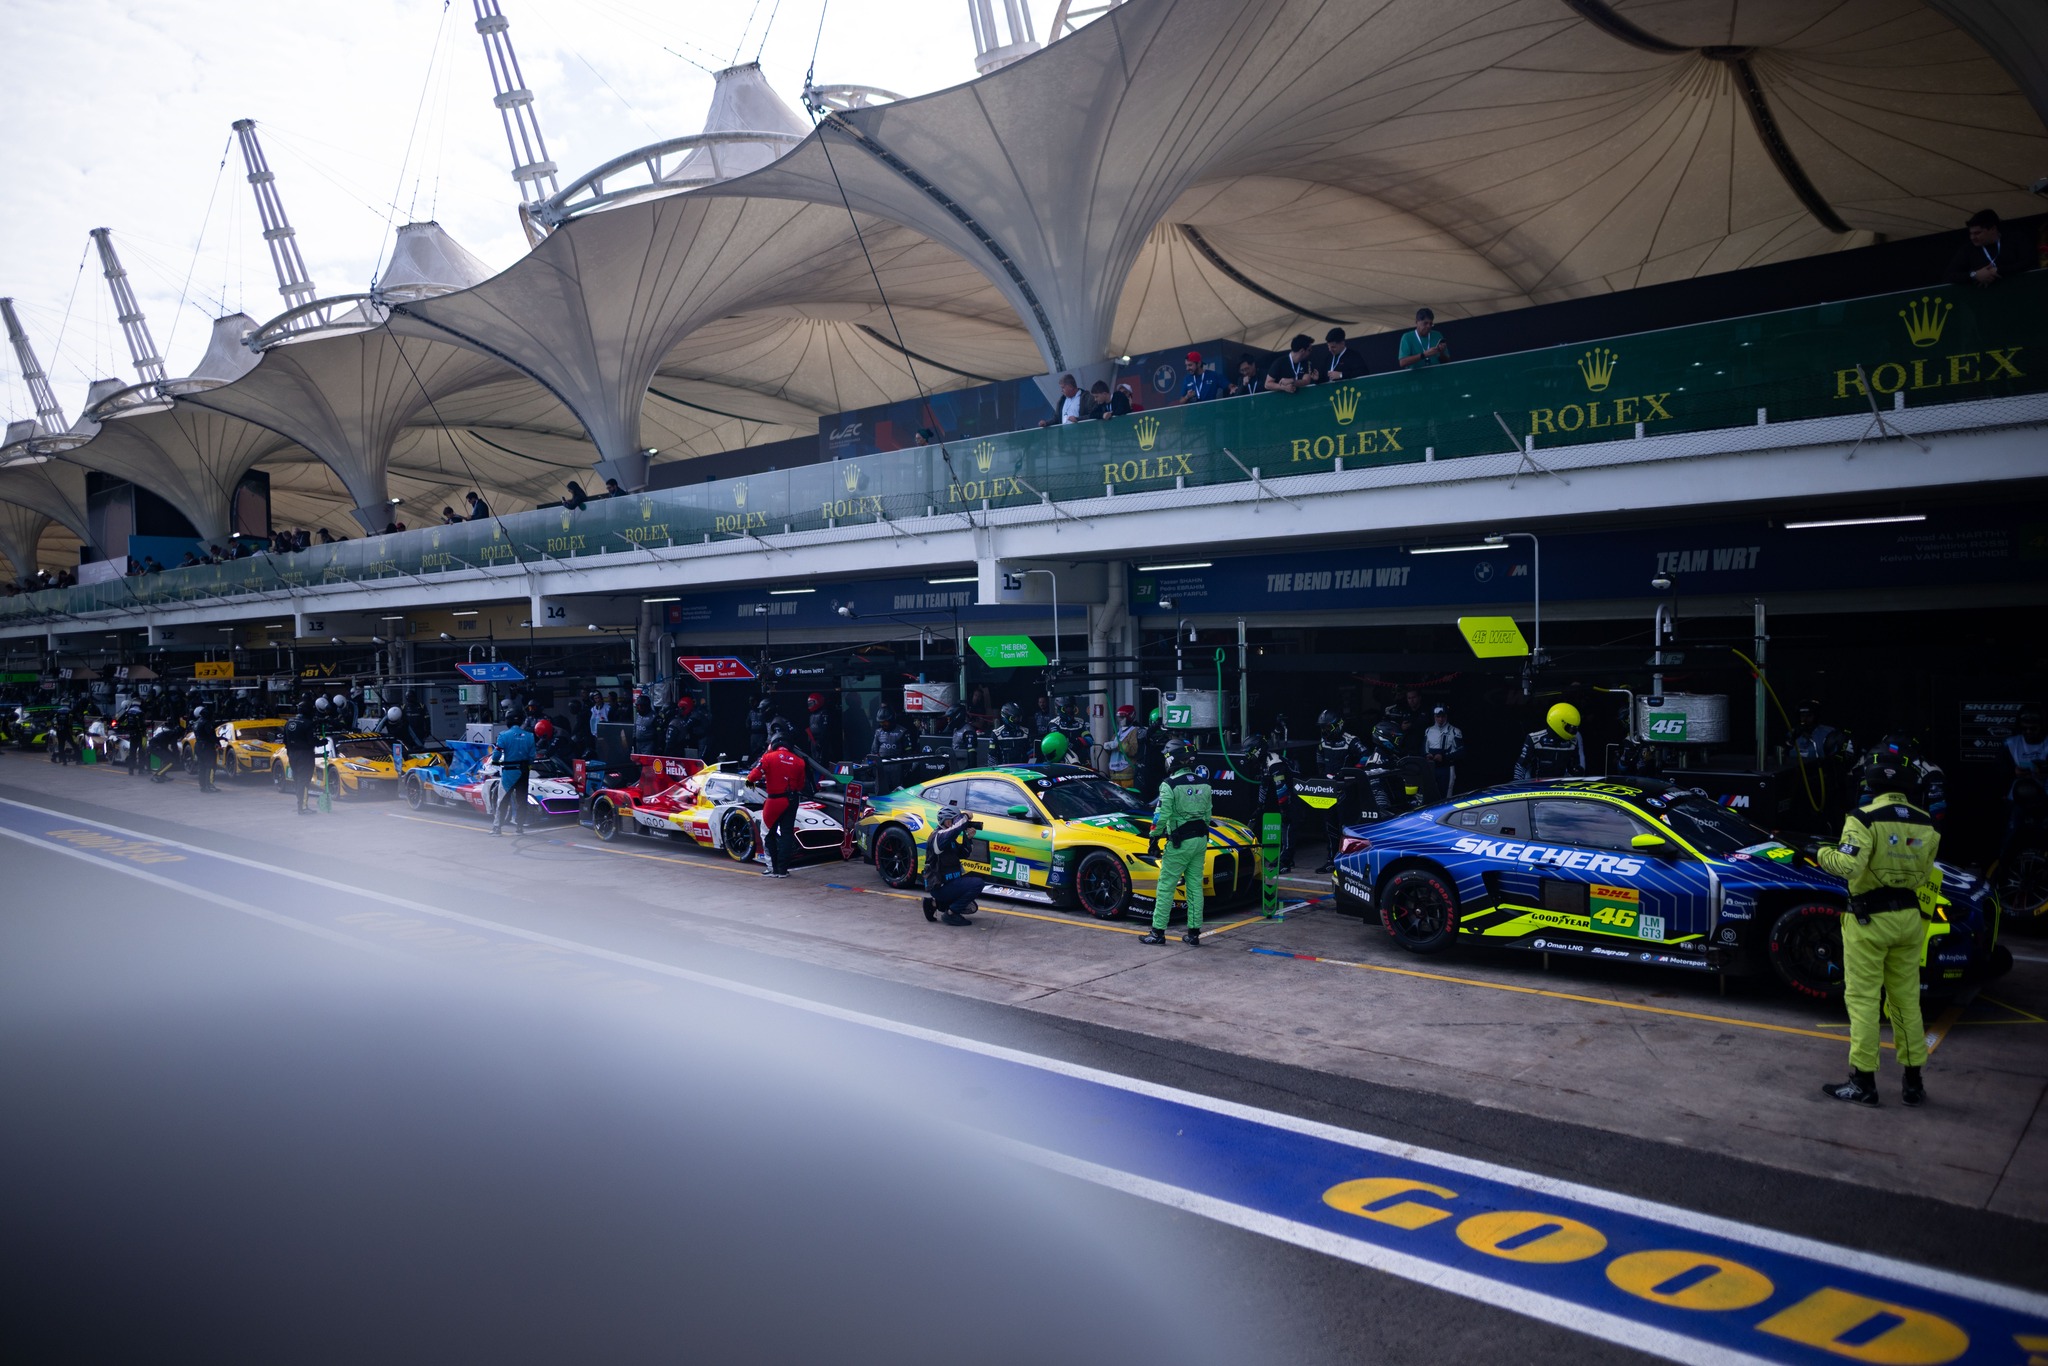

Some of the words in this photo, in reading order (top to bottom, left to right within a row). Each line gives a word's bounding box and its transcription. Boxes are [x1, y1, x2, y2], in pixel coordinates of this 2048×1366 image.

[1833, 346, 2028, 400] ROLEX
[1529, 392, 1674, 436] ROLEX
[1290, 427, 1405, 463] ROLEX
[1103, 453, 1194, 485] ROLEX
[949, 476, 1024, 503] ROLEX
[822, 494, 885, 520] ROLEX
[715, 511, 768, 533] ROLEX
[625, 524, 669, 544] ROLEX
[547, 534, 586, 552] ROLEX
[480, 544, 515, 560] ROLEX
[422, 552, 452, 566] ROLEX
[1656, 549, 1707, 574] TEAM
[1712, 546, 1761, 571] WRT
[324, 566, 347, 579] ROLEX
[370, 558, 396, 574] ROLEX
[1004, 574, 1022, 590] 15
[1267, 574, 1291, 592] THE
[1294, 571, 1331, 592] BEND
[1334, 568, 1373, 590] TEAM
[1376, 566, 1410, 587] WRT
[1136, 585, 1152, 596] 31
[894, 594, 915, 610] BMW
[925, 592, 948, 608] TEAM
[950, 591, 970, 607] WRT
[548, 606, 566, 618] 14
[782, 601, 798, 615] WRT
[309, 622, 324, 632] 13
[162, 632, 174, 640] 12
[1472, 630, 1487, 644] 46
[1488, 630, 1516, 644] WRT
[1014, 650, 1029, 658] WRT
[59, 668, 73, 679] 38
[114, 666, 129, 678] 12
[300, 669, 320, 678] #81
[472, 668, 486, 676] 15
[694, 664, 714, 672] 20
[1168, 710, 1190, 724] 31
[1651, 719, 1685, 734] 46
[666, 766, 688, 776] HELIX
[1211, 788, 1232, 796] orsport
[1304, 784, 1334, 794] AnyDesk
[644, 818, 665, 828] iQOO
[694, 828, 712, 837] 20
[992, 844, 1012, 854] DHL
[1450, 838, 1646, 877] SKECHERS
[960, 860, 990, 872] GOODYEAR
[992, 856, 1014, 875] 31
[1018, 864, 1028, 873] LM
[1018, 872, 1028, 881] GT3
[1344, 876, 1372, 891] experience
[1344, 882, 1370, 902] oman
[1596, 888, 1632, 900] DHL
[1128, 906, 1154, 915] GOODYE
[1593, 906, 1637, 928] 46
[1722, 910, 1752, 920] Omantel
[1801, 907, 1841, 916] GOOD
[1531, 912, 1590, 928] GOODYEAR
[1644, 915, 1660, 928] LM
[1642, 926, 1662, 940] GT3
[1547, 942, 1567, 950] Oman
[1568, 944, 1584, 952] LNG
[1591, 946, 1630, 957] Snap-on
[1670, 957, 1707, 968] Motorsport
[1321, 1177, 2048, 1366] GOOD
